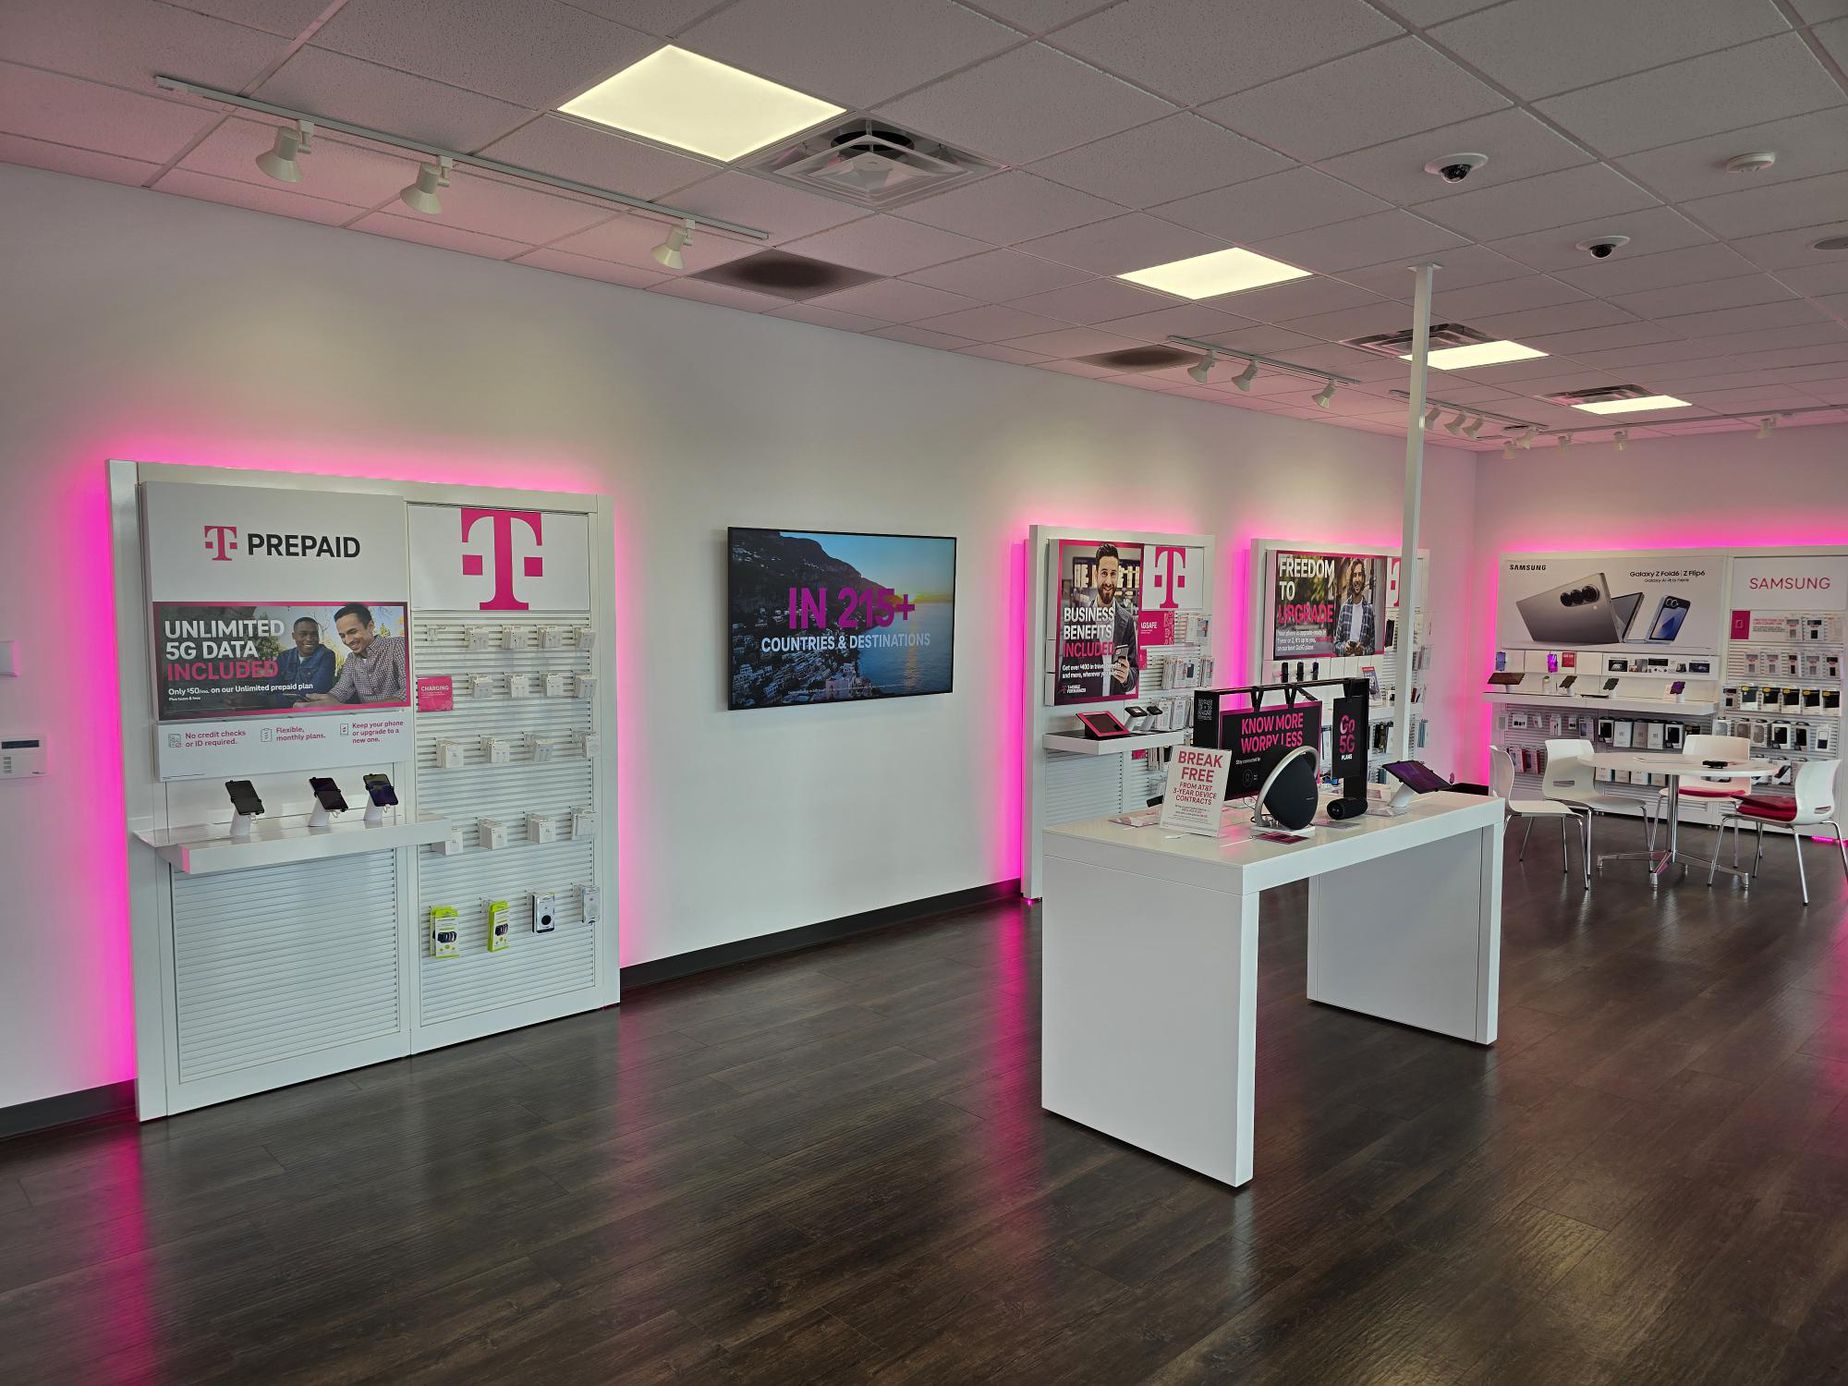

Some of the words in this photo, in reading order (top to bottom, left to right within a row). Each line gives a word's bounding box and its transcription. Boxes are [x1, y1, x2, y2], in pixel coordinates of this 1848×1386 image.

[247, 533, 360, 558] PREPAID
[1279, 558, 1335, 578] FREEDOM
[1629, 571, 1654, 579] Galaxy
[1688, 570, 1706, 578] Flip6
[1279, 581, 1296, 601] TO
[1749, 577, 1831, 590] SAMSUNG
[789, 587, 828, 630] IN
[838, 587, 915, 628] 215+
[1064, 607, 1114, 622] BUSINESS
[1278, 603, 1334, 624] UPGRADE
[164, 620, 285, 639] UNLIMITED
[1063, 625, 1112, 640] BENEFITS
[166, 641, 197, 660] 5G
[202, 641, 259, 659] DATA
[761, 635, 835, 652] COUNTRIES
[838, 635, 848, 650] &
[849, 633, 931, 649] DESTINATIONS
[167, 661, 279, 681] INCLUDED
[168, 688, 187, 697] Only
[235, 684, 270, 692] Unlimited
[270, 683, 298, 692] prepaid
[384, 720, 404, 728] phone
[1241, 716, 1274, 735] KNOW
[1275, 712, 1304, 731] MORE
[197, 731, 219, 739] credit
[221, 730, 246, 738] checks
[276, 735, 305, 743] monthly
[305, 733, 326, 741] plans.
[360, 729, 386, 737] upgrade
[205, 739, 237, 748] required.
[1339, 734, 1356, 753] 5G
[1178, 751, 1223, 768] BREAK
[1181, 766, 1215, 783] FREE
[1173, 787, 1195, 796] 3-YEAR
[1195, 791, 1217, 800] DEVICE
[1180, 782, 1197, 790] FROM
[1198, 784, 1213, 792] AT&T
[1176, 794, 1212, 805] CONTRACTS
